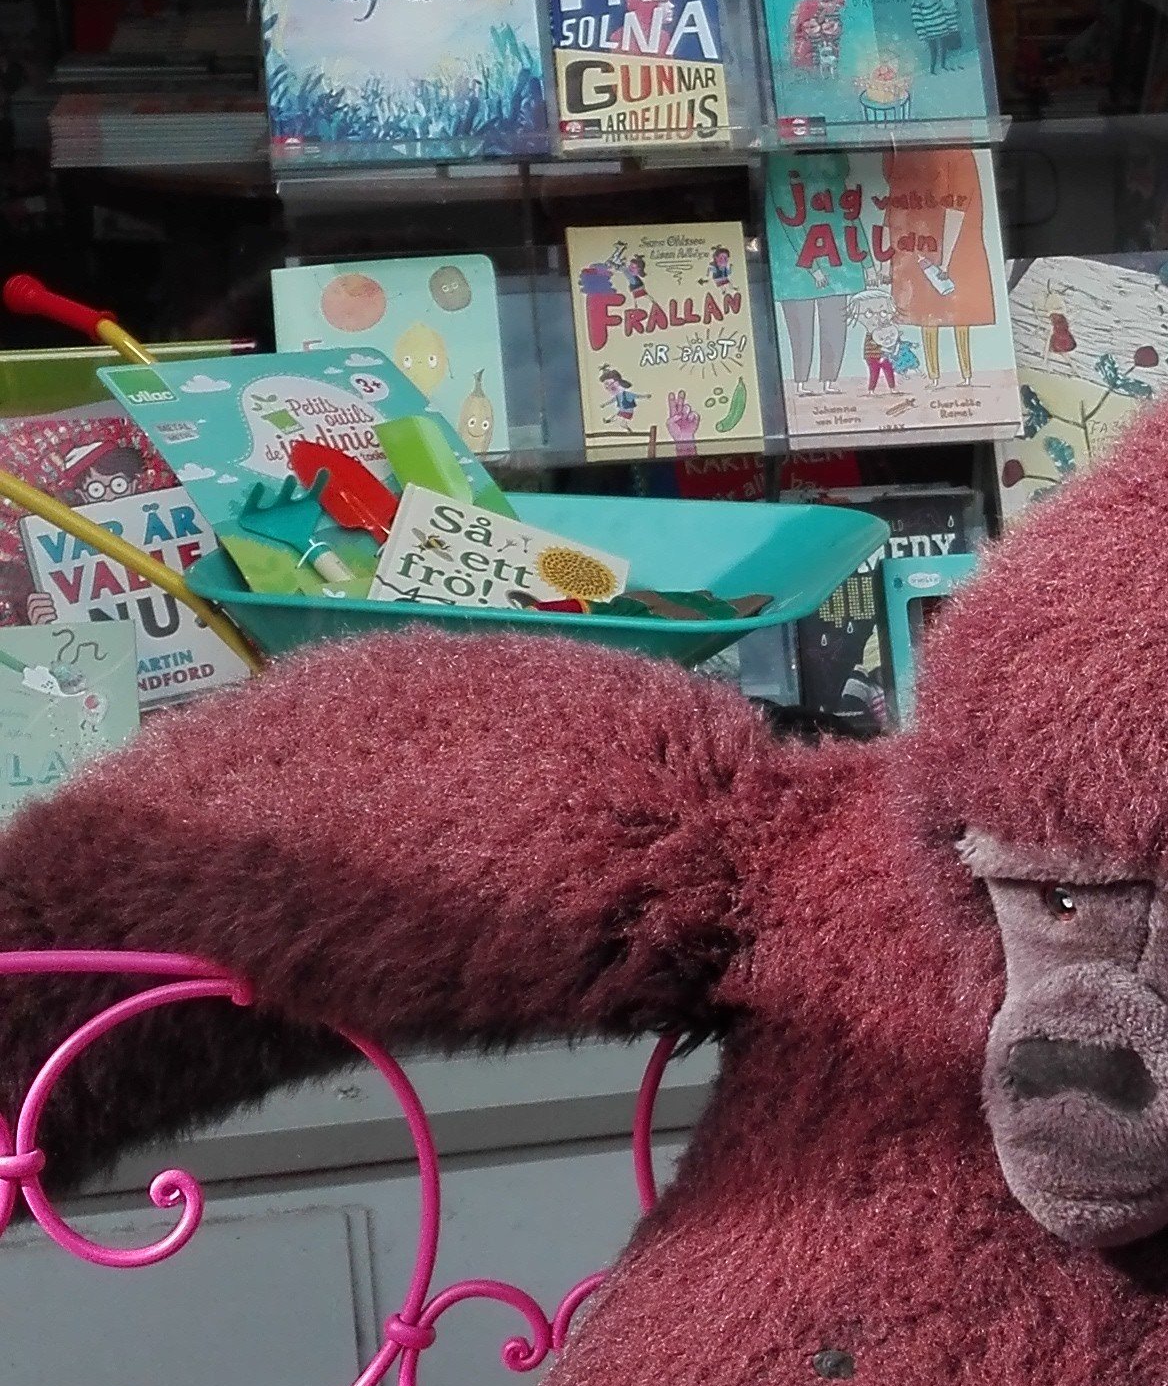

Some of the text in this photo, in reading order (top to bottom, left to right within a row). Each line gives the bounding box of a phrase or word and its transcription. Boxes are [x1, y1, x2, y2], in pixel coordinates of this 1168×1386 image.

[559, 0, 719, 60] SOLNA
[565, 59, 717, 115] GUNNAR
[604, 93, 719, 143] ARDELIUS
[871, 189, 968, 210] vaktar
[586, 291, 742, 351] FRALLAN
[639, 334, 747, 367] ÄR BÄST!
[128, 389, 174, 404] vilac
[356, 378, 382, 394] 3+
[285, 397, 338, 416] Petits
[324, 404, 374, 426] outils
[265, 444, 283, 462] de
[142, 502, 203, 545] ÄR
[429, 504, 493, 548] Så
[397, 551, 494, 605] frö!
[459, 550, 534, 589] ett
[138, 649, 193, 675] ARTIN
[138, 663, 215, 692] NDFORD
